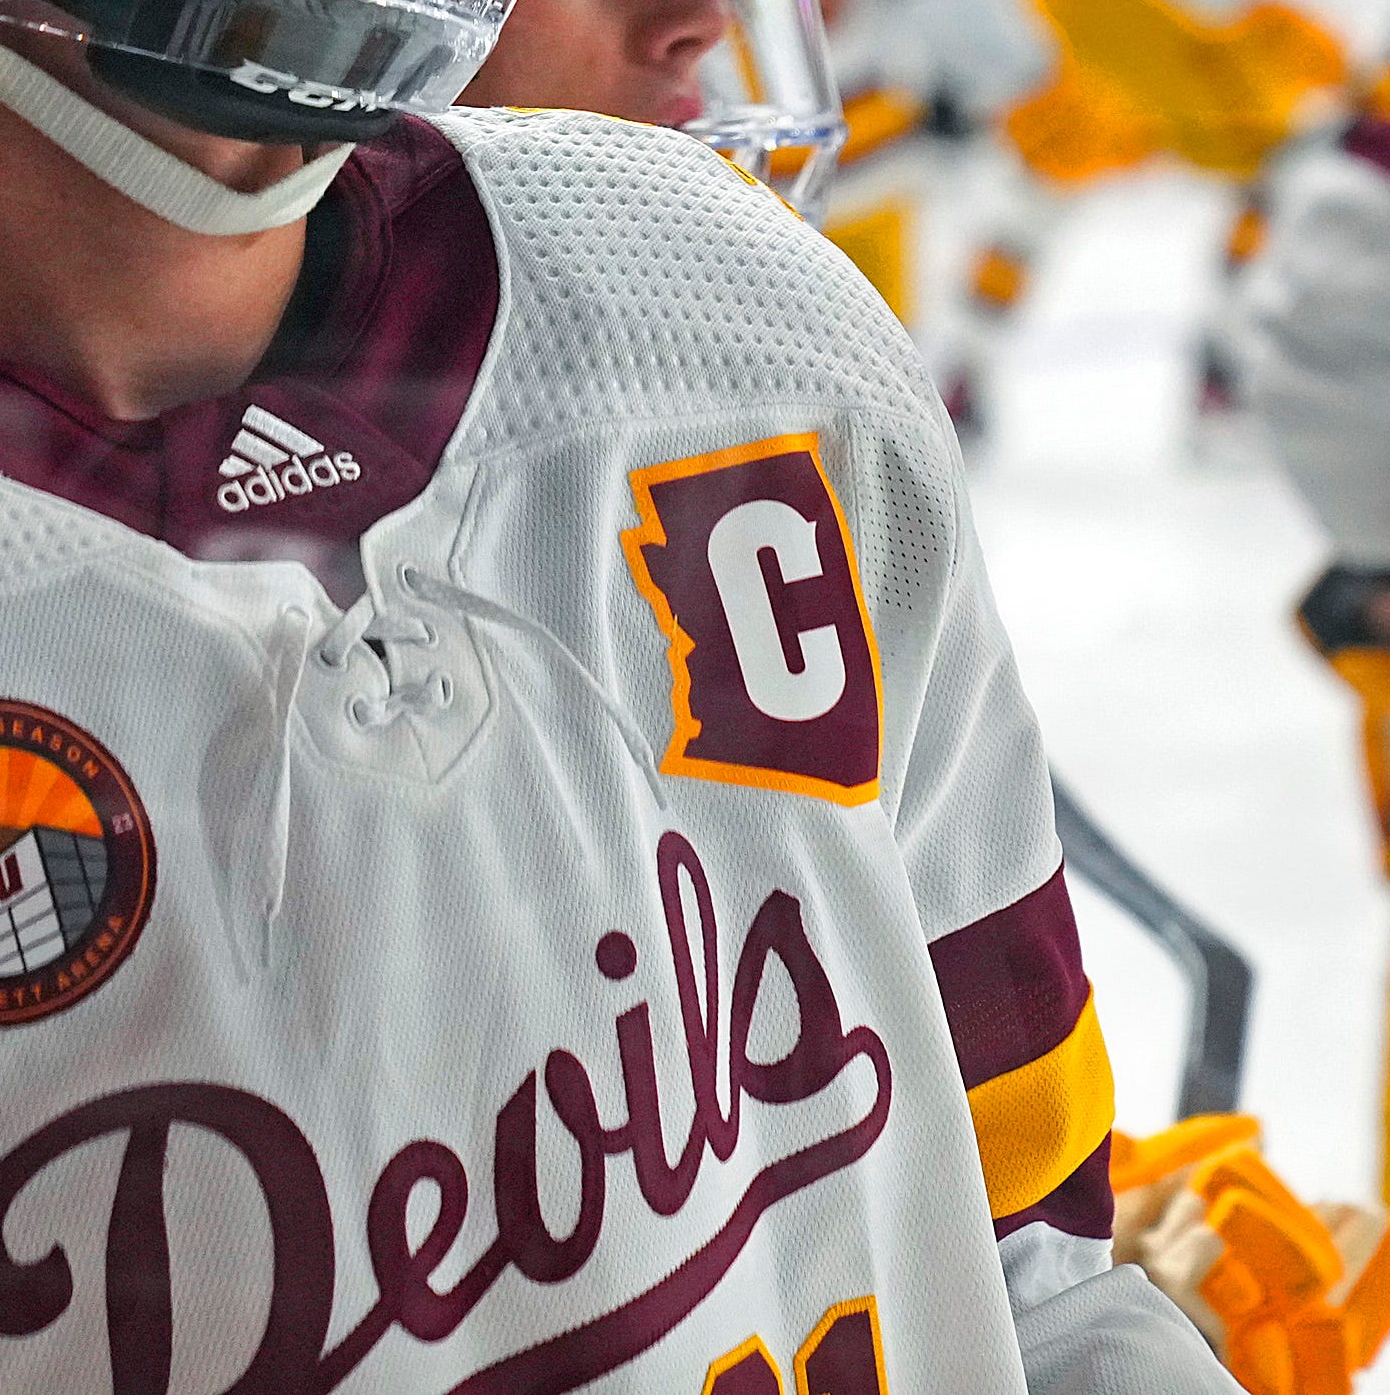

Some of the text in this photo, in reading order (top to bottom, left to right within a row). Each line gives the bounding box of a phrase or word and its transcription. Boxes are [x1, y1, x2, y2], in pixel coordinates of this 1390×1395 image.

[215, 448, 362, 513] adidas
[707, 499, 847, 722] C
[58, 915, 123, 990] ARENA
